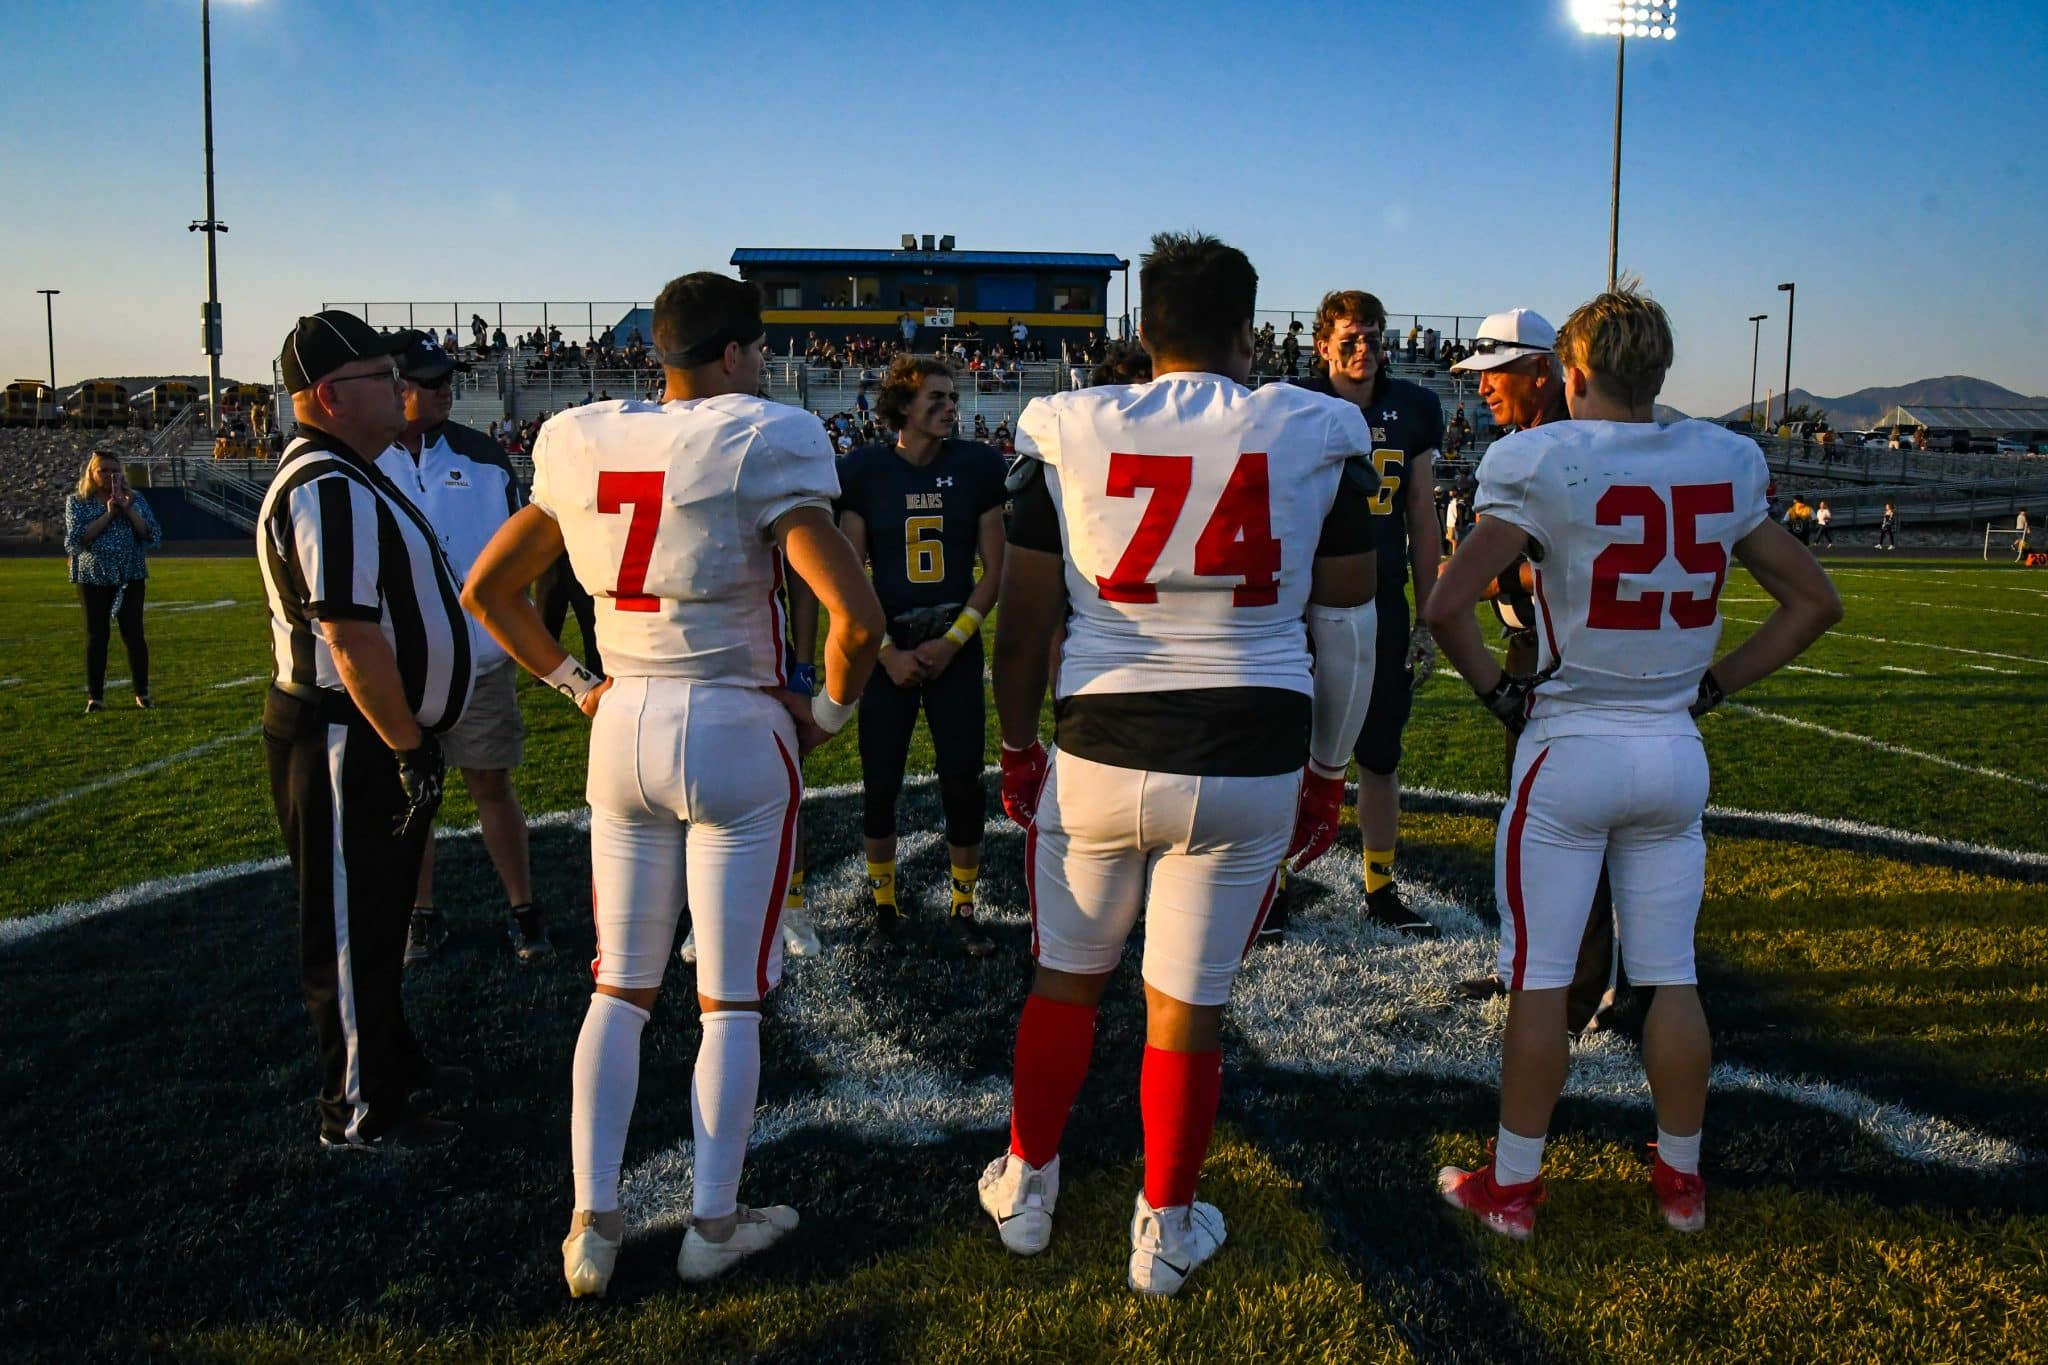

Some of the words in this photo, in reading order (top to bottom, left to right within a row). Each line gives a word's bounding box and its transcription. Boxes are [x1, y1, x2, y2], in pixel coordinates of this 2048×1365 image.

[597, 471, 665, 612] 7
[905, 515, 945, 583] 6
[1096, 452, 1281, 607] 74
[1586, 482, 1734, 630] 25
[2031, 554, 2047, 565] 20
